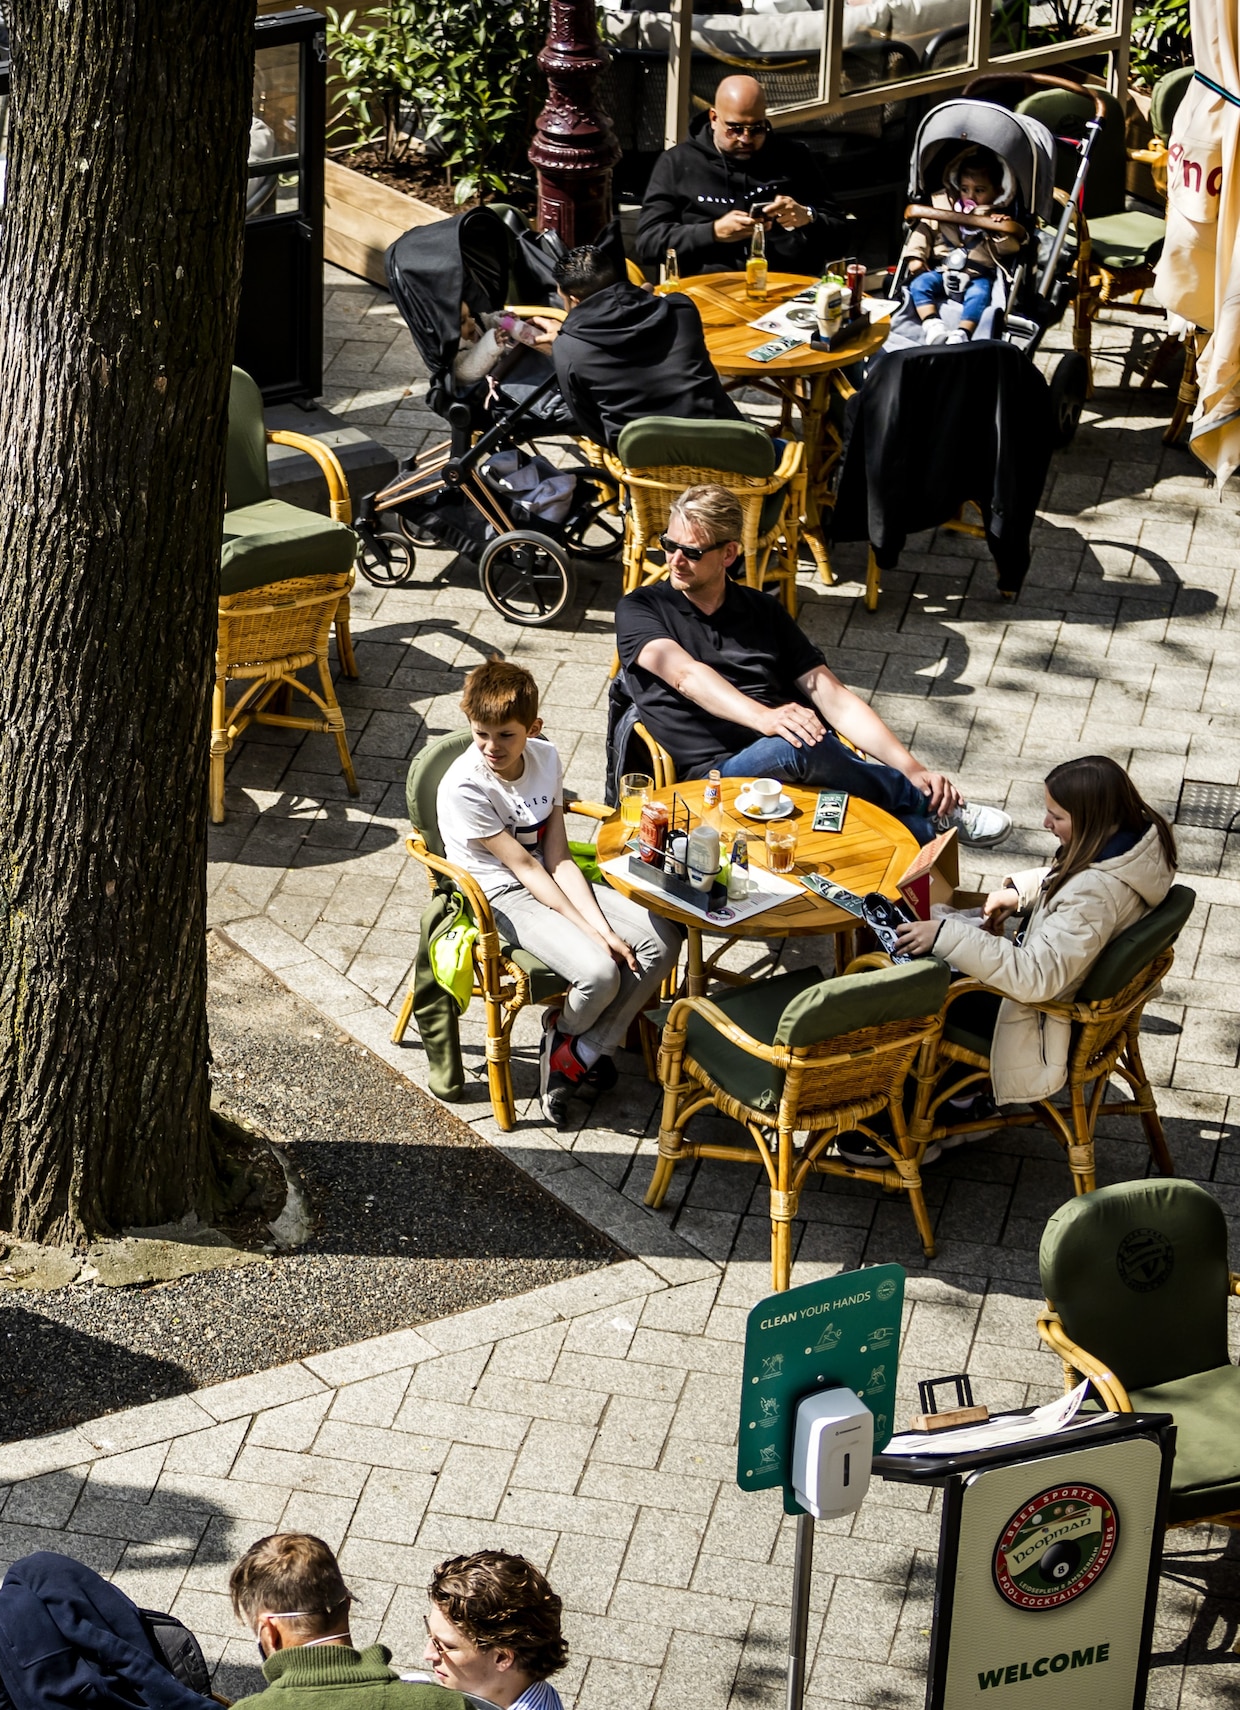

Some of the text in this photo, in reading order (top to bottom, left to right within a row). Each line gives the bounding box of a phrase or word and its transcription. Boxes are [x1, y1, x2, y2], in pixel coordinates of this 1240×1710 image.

[760, 1291, 871, 1330] CLEAN YOUR HANDS
[1007, 1489, 1094, 1537] BEER SPORTS
[1000, 1526, 1114, 1605] POOL COCKTAILS BURGERS
[1019, 1581, 1060, 1594] LEIDSEPLEIN
[1067, 1546, 1099, 1586] AMSTERDAM
[1057, 1565, 1065, 1575] 8
[977, 1643, 1110, 1690] WELCOME
